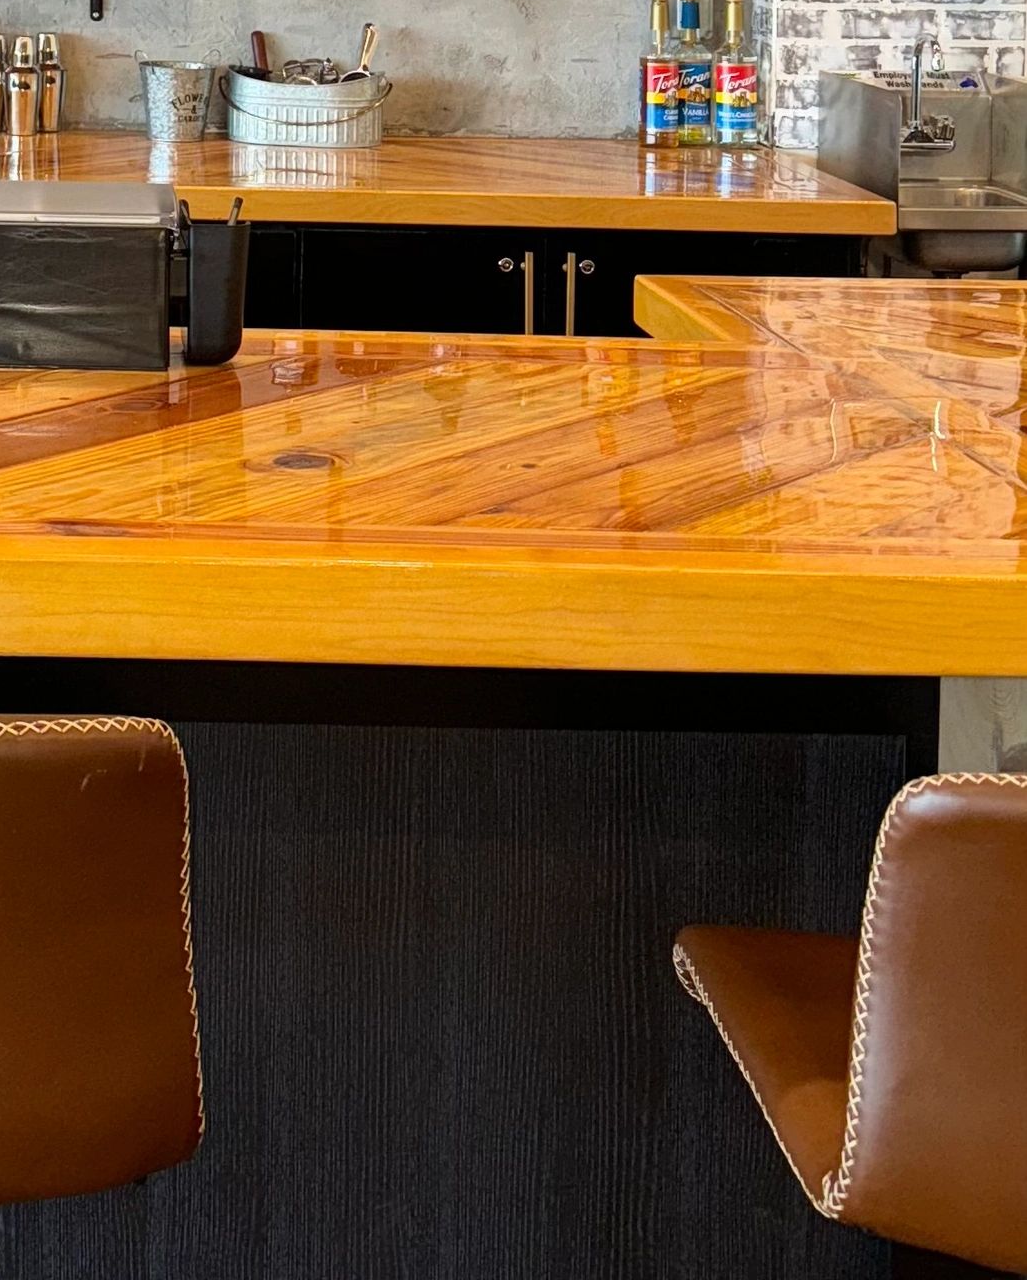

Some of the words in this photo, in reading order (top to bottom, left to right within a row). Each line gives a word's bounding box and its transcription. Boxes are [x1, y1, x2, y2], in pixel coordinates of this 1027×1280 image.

[652, 72, 679, 95] Tora
[677, 68, 711, 89] Toran
[926, 71, 950, 80] Must
